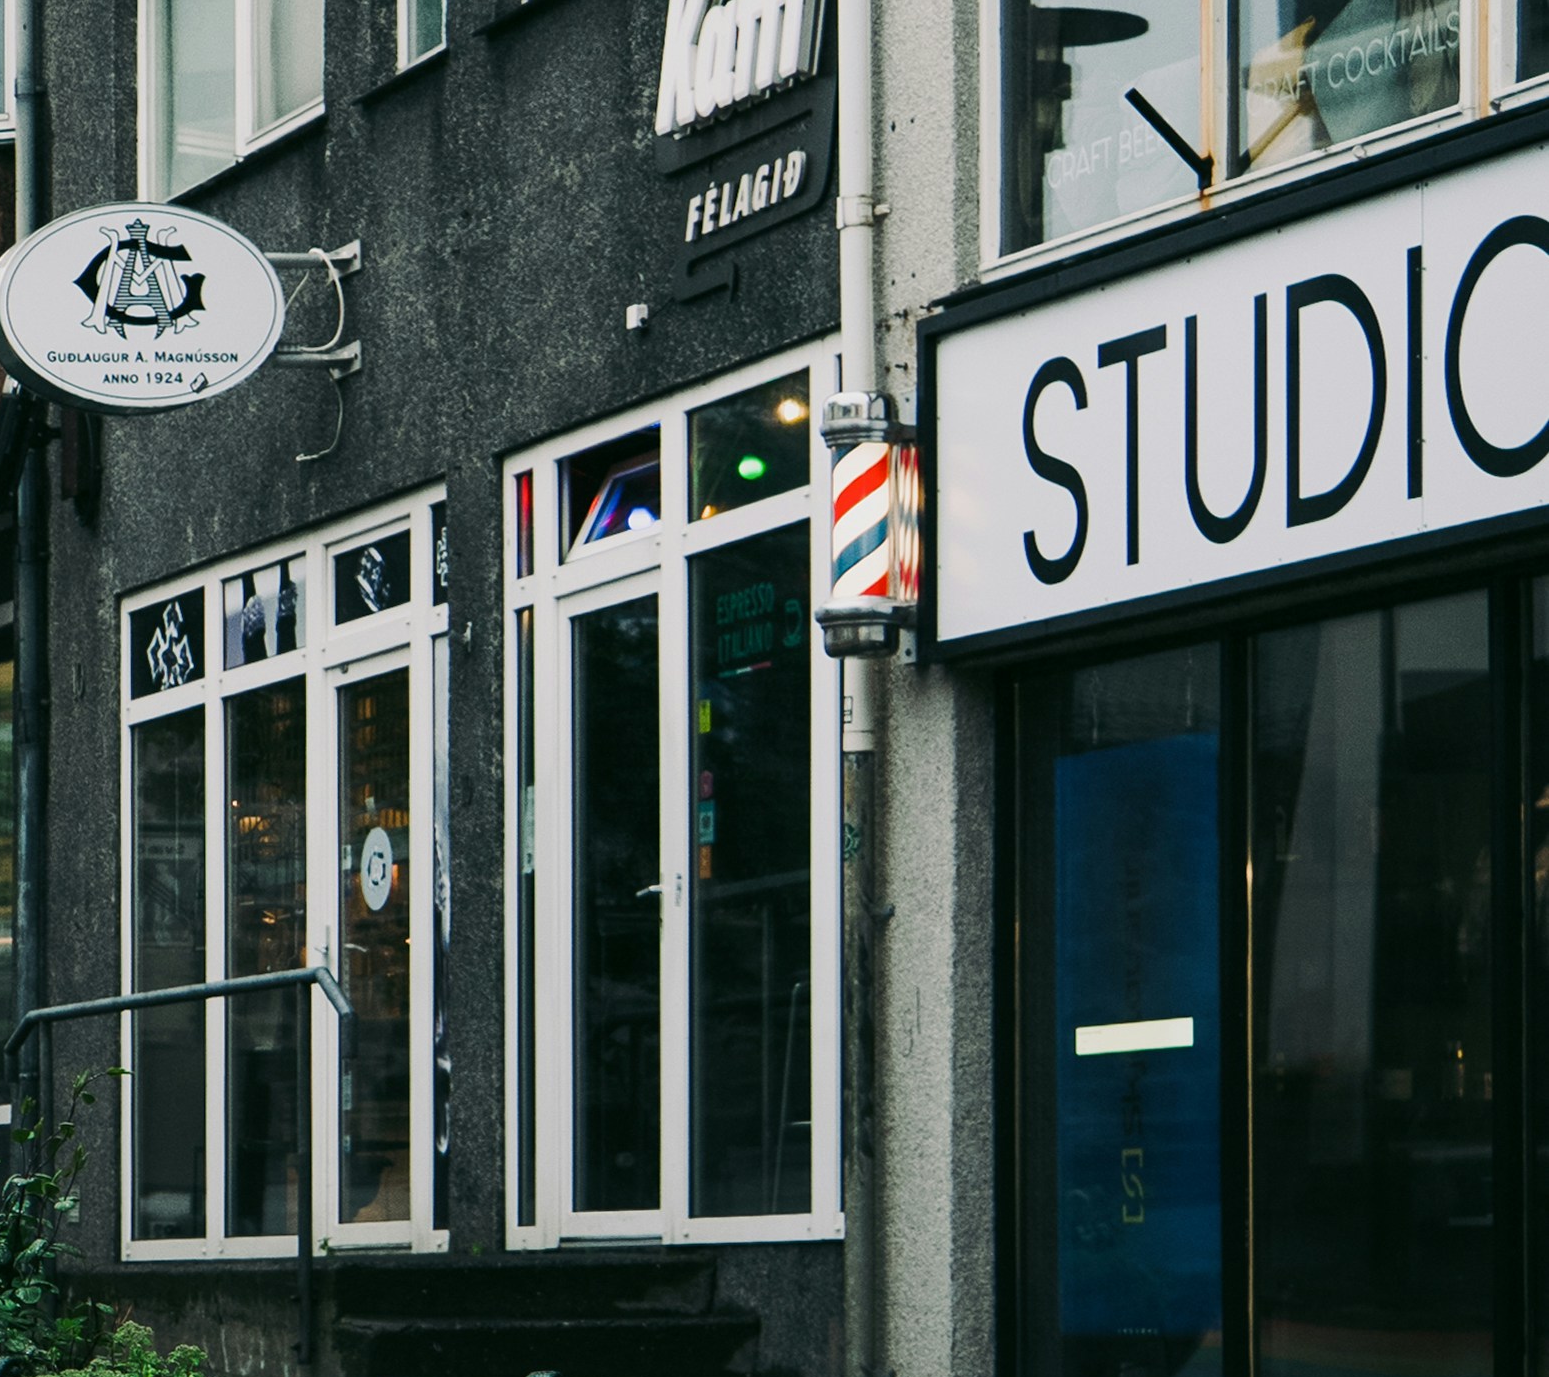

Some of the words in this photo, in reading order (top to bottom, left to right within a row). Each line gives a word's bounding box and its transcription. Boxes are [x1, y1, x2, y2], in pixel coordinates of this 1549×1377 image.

[1251, 60, 1321, 102] CRAFT
[1327, 10, 1460, 89] COCKTAILS
[685, 150, 806, 242] FÉLAGIÐ
[1048, 131, 1111, 190] CRAFT
[1119, 123, 1163, 164] BEE
[103, 373, 139, 384] ANNO
[146, 372, 184, 384] 1924
[135, 351, 148, 363] A.
[1022, 215, 1549, 585] STUDIO
